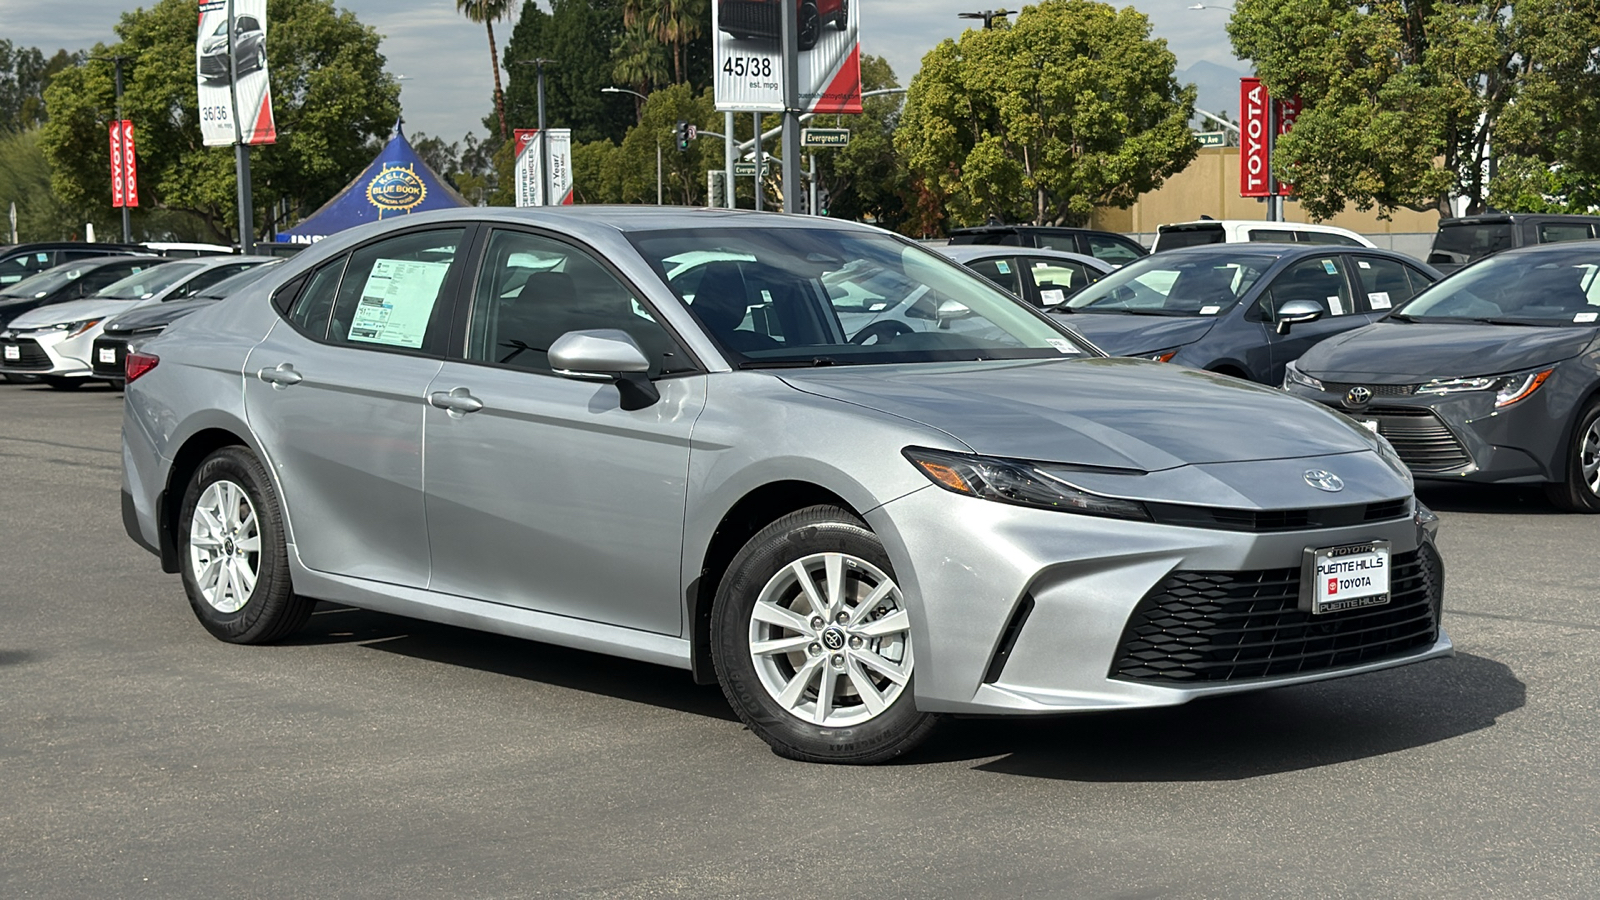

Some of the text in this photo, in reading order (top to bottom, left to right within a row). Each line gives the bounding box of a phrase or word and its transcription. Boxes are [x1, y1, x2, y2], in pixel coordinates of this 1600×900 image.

[723, 57, 771, 77] 45/38
[763, 82, 778, 90] mpg
[202, 105, 227, 121] 36/36
[807, 133, 847, 144] Evergreen Pl
[1207, 136, 1219, 144] Ave
[1247, 86, 1262, 190] TOYOTA
[112, 126, 123, 202] TOYOTA
[124, 125, 136, 202] TOYOTA
[378, 172, 418, 185] KELLEY
[372, 185, 421, 195] BLUE BOOK
[291, 234, 328, 245] INS
[1333, 545, 1373, 556] TOYOTA
[1316, 557, 1383, 576] PUENTE HILLS
[1339, 576, 1371, 590] TOYOTA
[1320, 595, 1387, 612] PUENTE HILLS
